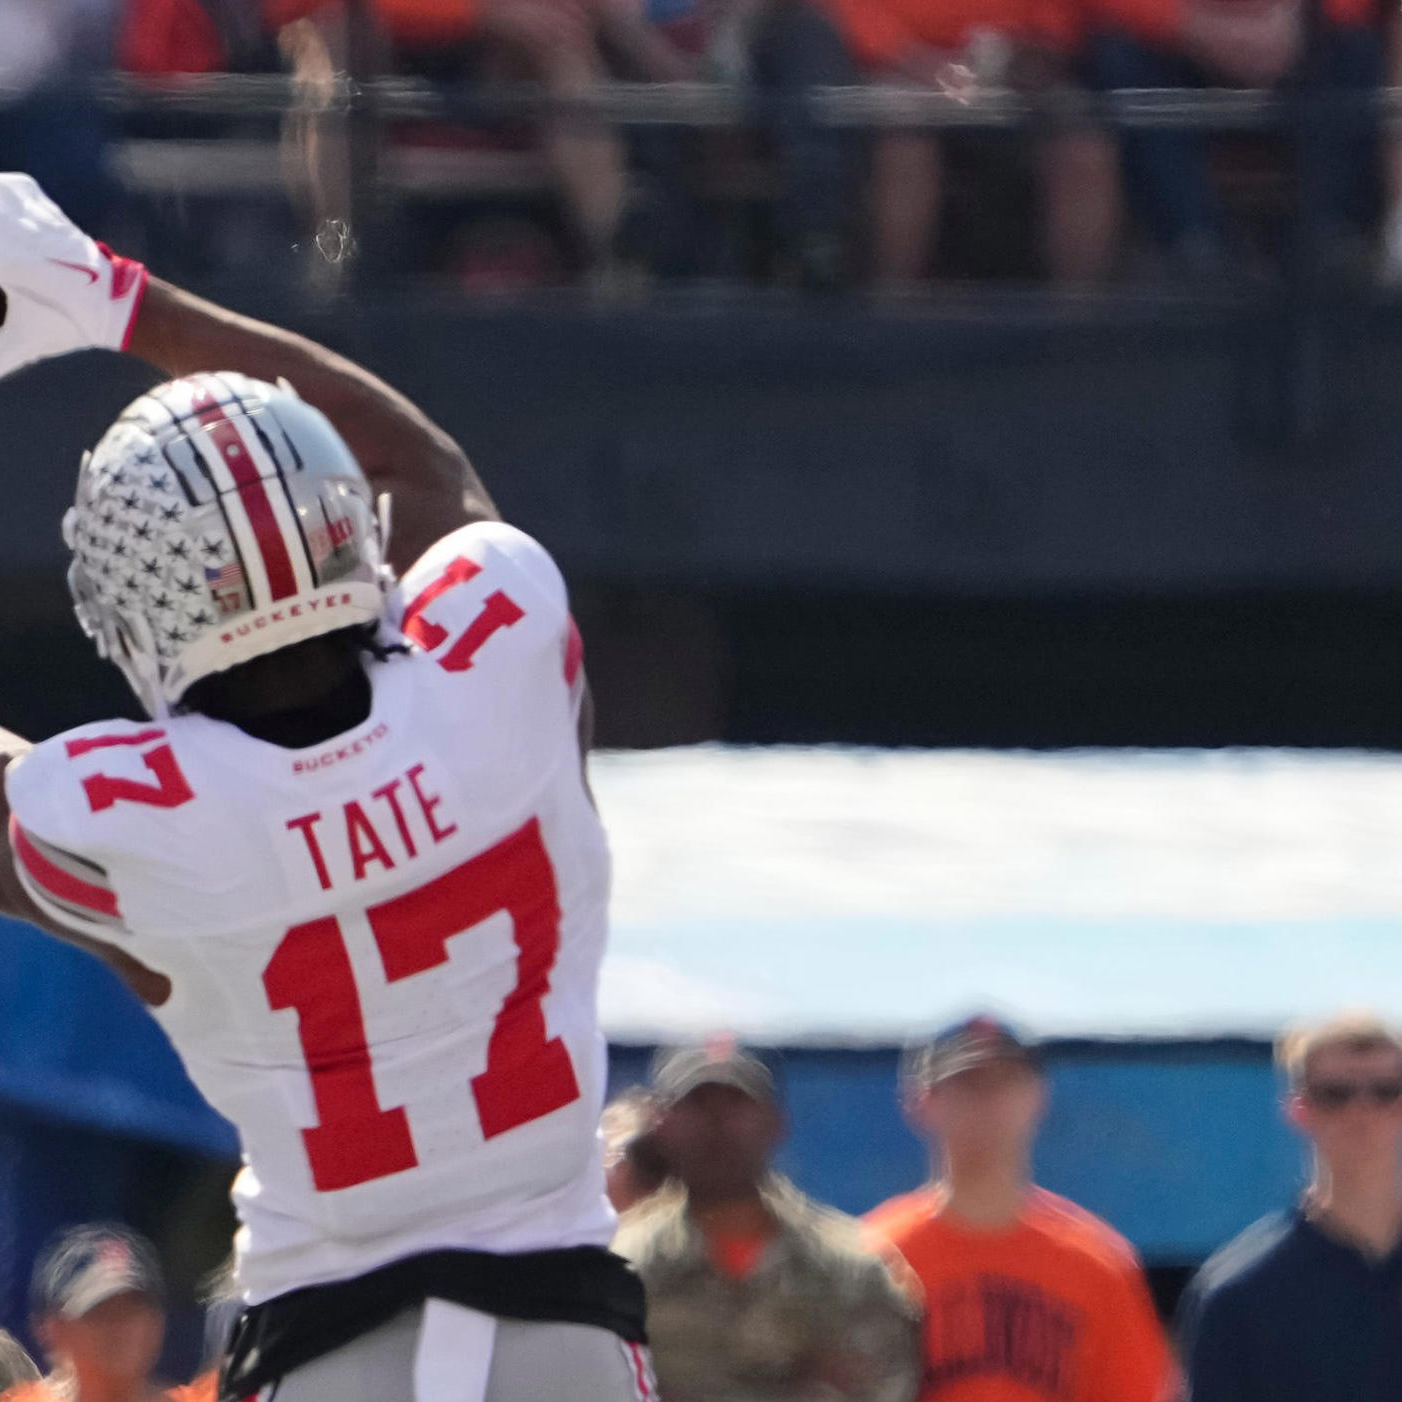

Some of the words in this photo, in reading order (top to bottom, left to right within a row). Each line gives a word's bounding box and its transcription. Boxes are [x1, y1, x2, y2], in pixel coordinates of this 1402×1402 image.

[220, 592, 352, 643] BUCKEYES
[399, 555, 526, 673] 17
[64, 728, 195, 813] 17
[285, 763, 458, 890] TATE
[262, 817, 581, 1192] 17
